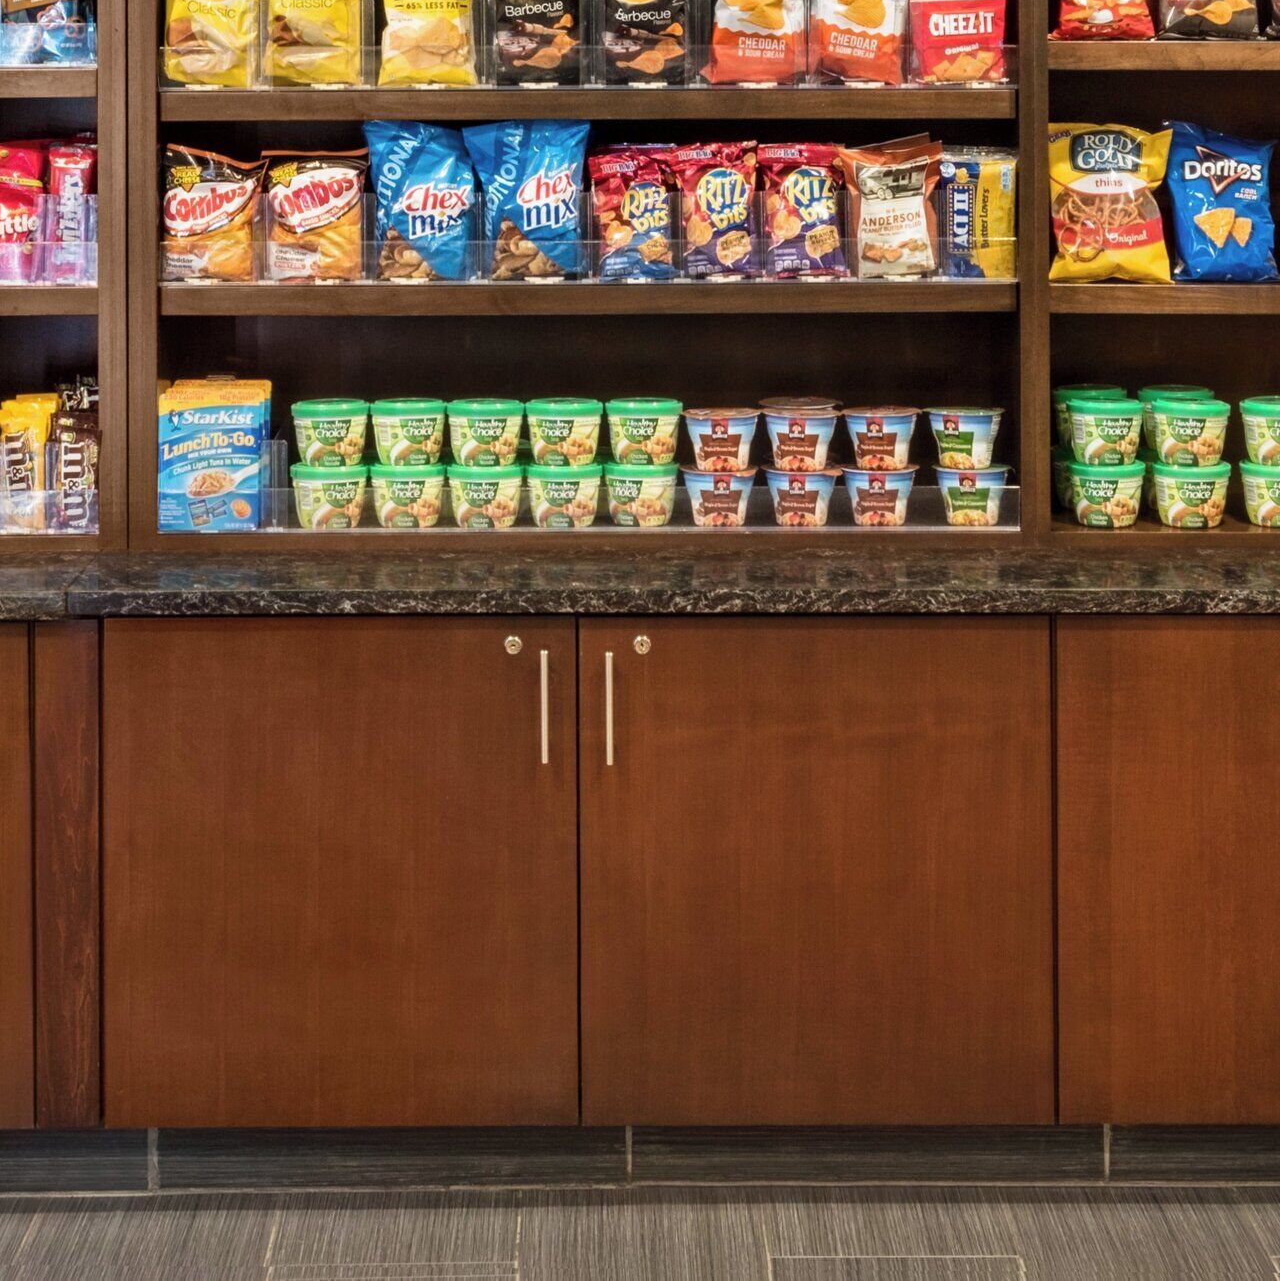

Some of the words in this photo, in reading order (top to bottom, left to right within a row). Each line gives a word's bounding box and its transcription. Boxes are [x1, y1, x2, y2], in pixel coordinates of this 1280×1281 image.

[187, 0, 237, 20] Classic
[406, 2, 423, 10] 65%
[443, 1, 459, 9] FAT
[504, 0, 565, 18] Barbecue
[738, 37, 786, 50] CHEDDAR
[830, 32, 878, 50] CHEDDAR
[738, 49, 745, 57] &
[745, 49, 763, 58] SOUR
[763, 49, 786, 59] CREAM
[1082, 135, 1132, 152] ROLD
[1077, 145, 1134, 169] GOLD
[1183, 160, 1262, 181] Doritos
[519, 171, 575, 204] Chex
[700, 173, 748, 212] RITZ
[788, 173, 833, 208] RITZ
[164, 184, 248, 222] Combos
[403, 183, 469, 212] Chex
[623, 186, 668, 220] RITZ
[525, 197, 577, 228] mix
[632, 210, 669, 233] bits
[711, 206, 748, 230] bits
[862, 211, 921, 227] ANDERSON
[410, 211, 463, 237] mix
[182, 410, 255, 425] StarKist
[315, 427, 348, 438] Choice
[403, 426, 433, 436] Choice
[471, 427, 502, 437] Choice
[540, 427, 569, 437] Choice
[1098, 426, 1129, 436] Choice
[464, 490, 495, 500] Choice
